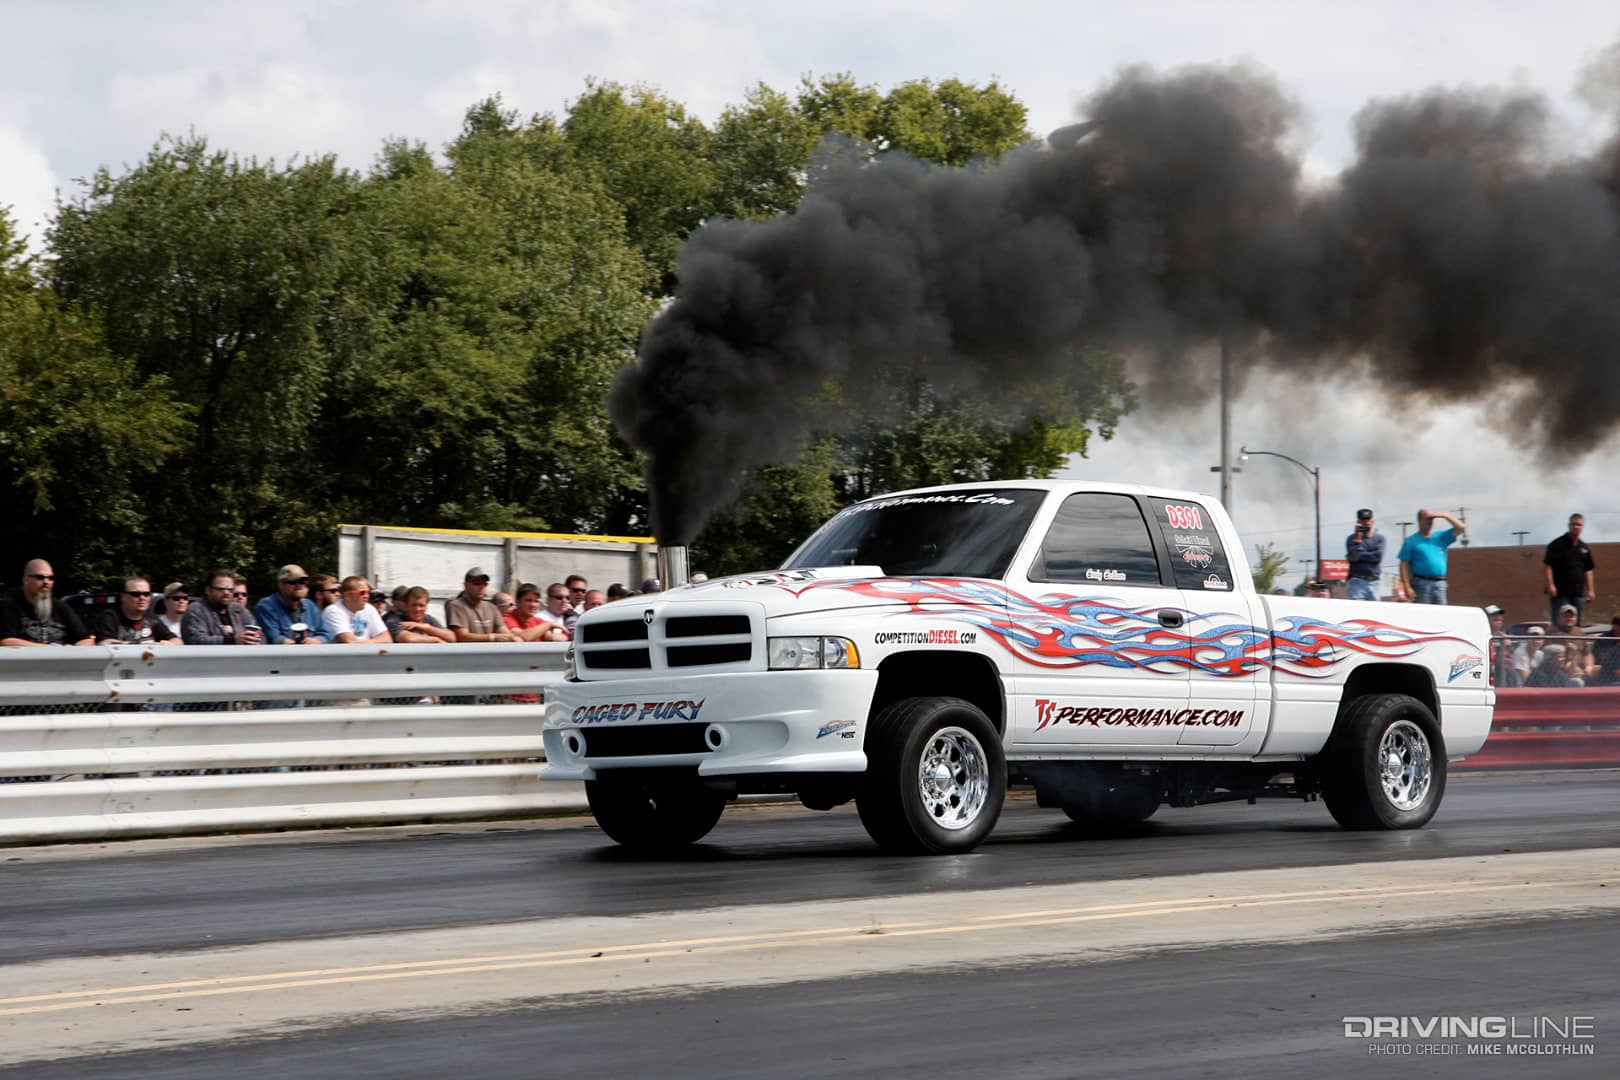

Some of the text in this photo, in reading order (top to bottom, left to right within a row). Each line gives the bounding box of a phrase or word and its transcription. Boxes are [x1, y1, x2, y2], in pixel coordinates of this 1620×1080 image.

[874, 629, 977, 645] COMPETITIONDIESEL.COM
[571, 698, 706, 724] CAGED FURY
